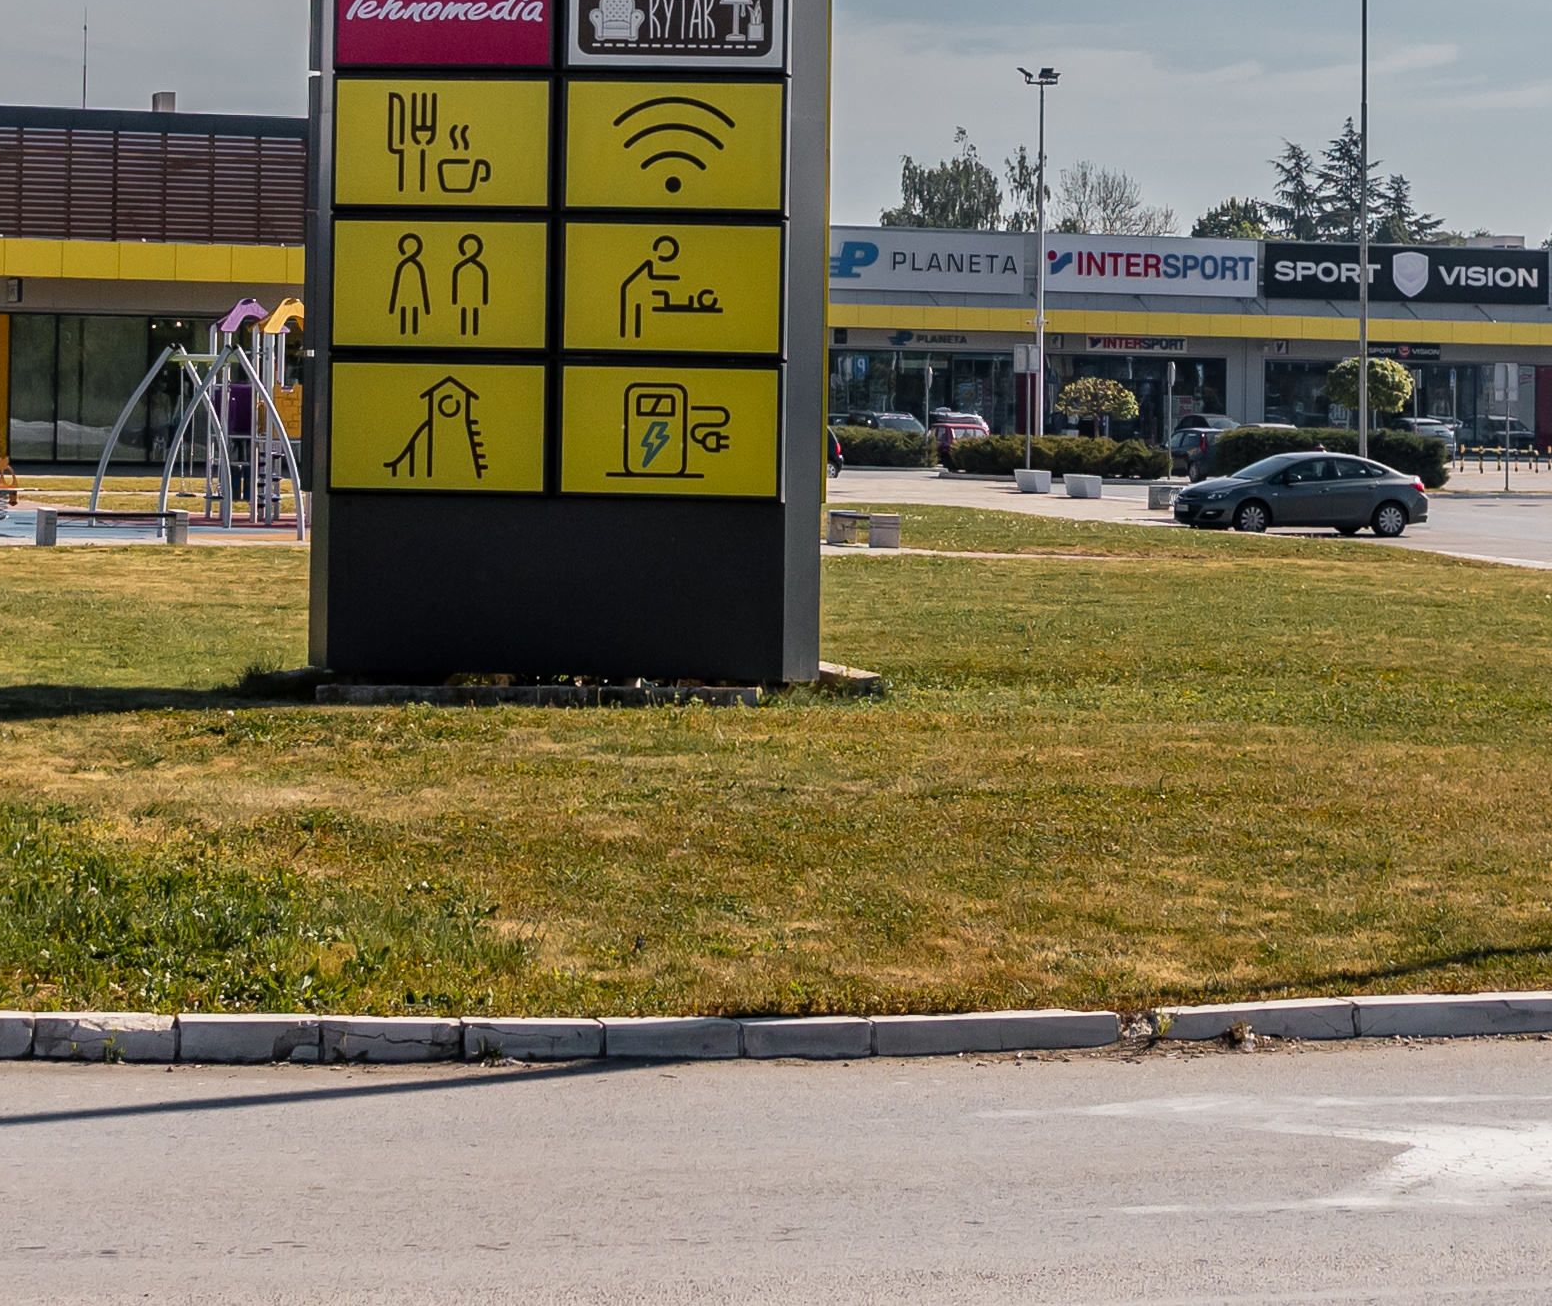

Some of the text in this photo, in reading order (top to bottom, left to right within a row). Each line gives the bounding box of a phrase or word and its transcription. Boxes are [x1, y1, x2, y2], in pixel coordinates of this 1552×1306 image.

[891, 250, 1019, 275] PLANETA
[1076, 249, 1256, 281] INTERSPORT
[1274, 260, 1539, 288] SPORT VISION
[916, 333, 968, 346] PLANETA
[1102, 336, 1186, 352] INTERSPORT
